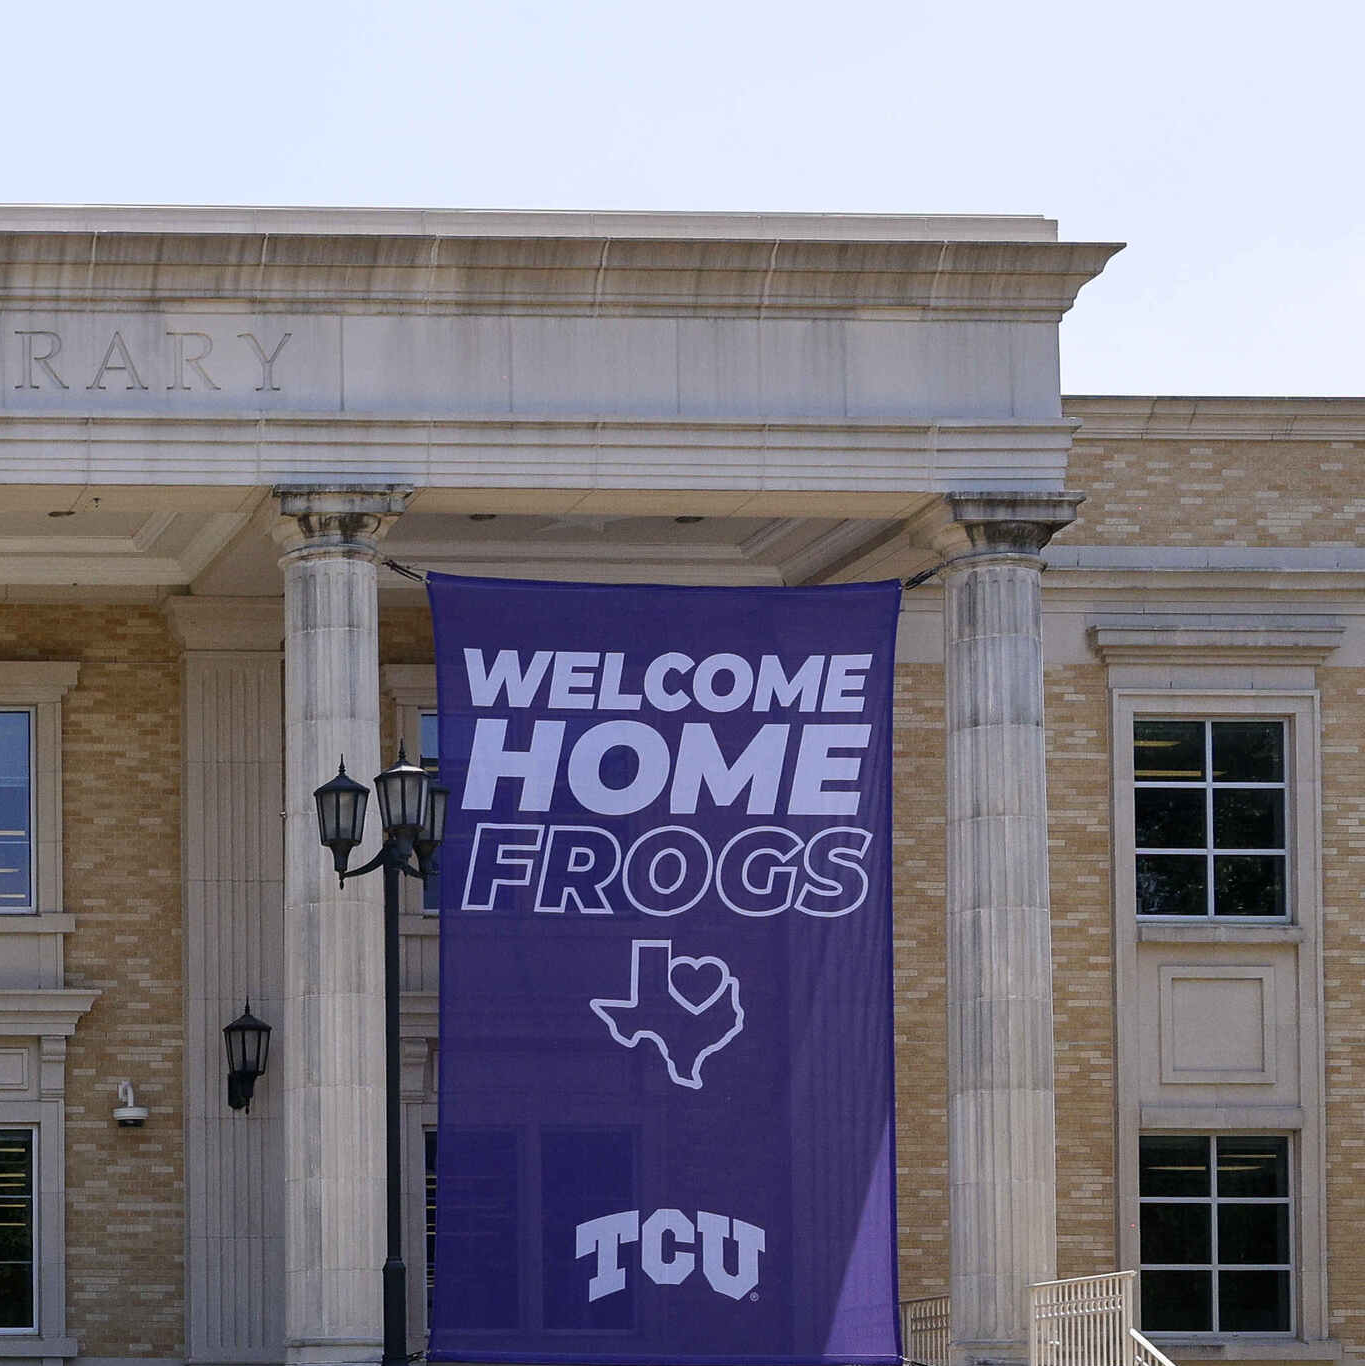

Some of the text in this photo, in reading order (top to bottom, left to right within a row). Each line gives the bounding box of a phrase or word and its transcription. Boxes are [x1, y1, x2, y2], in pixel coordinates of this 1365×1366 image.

[463, 648, 873, 712] WELCOME
[461, 718, 872, 816] HOME
[461, 823, 873, 918] FROGS
[575, 1208, 766, 1303] TCU
